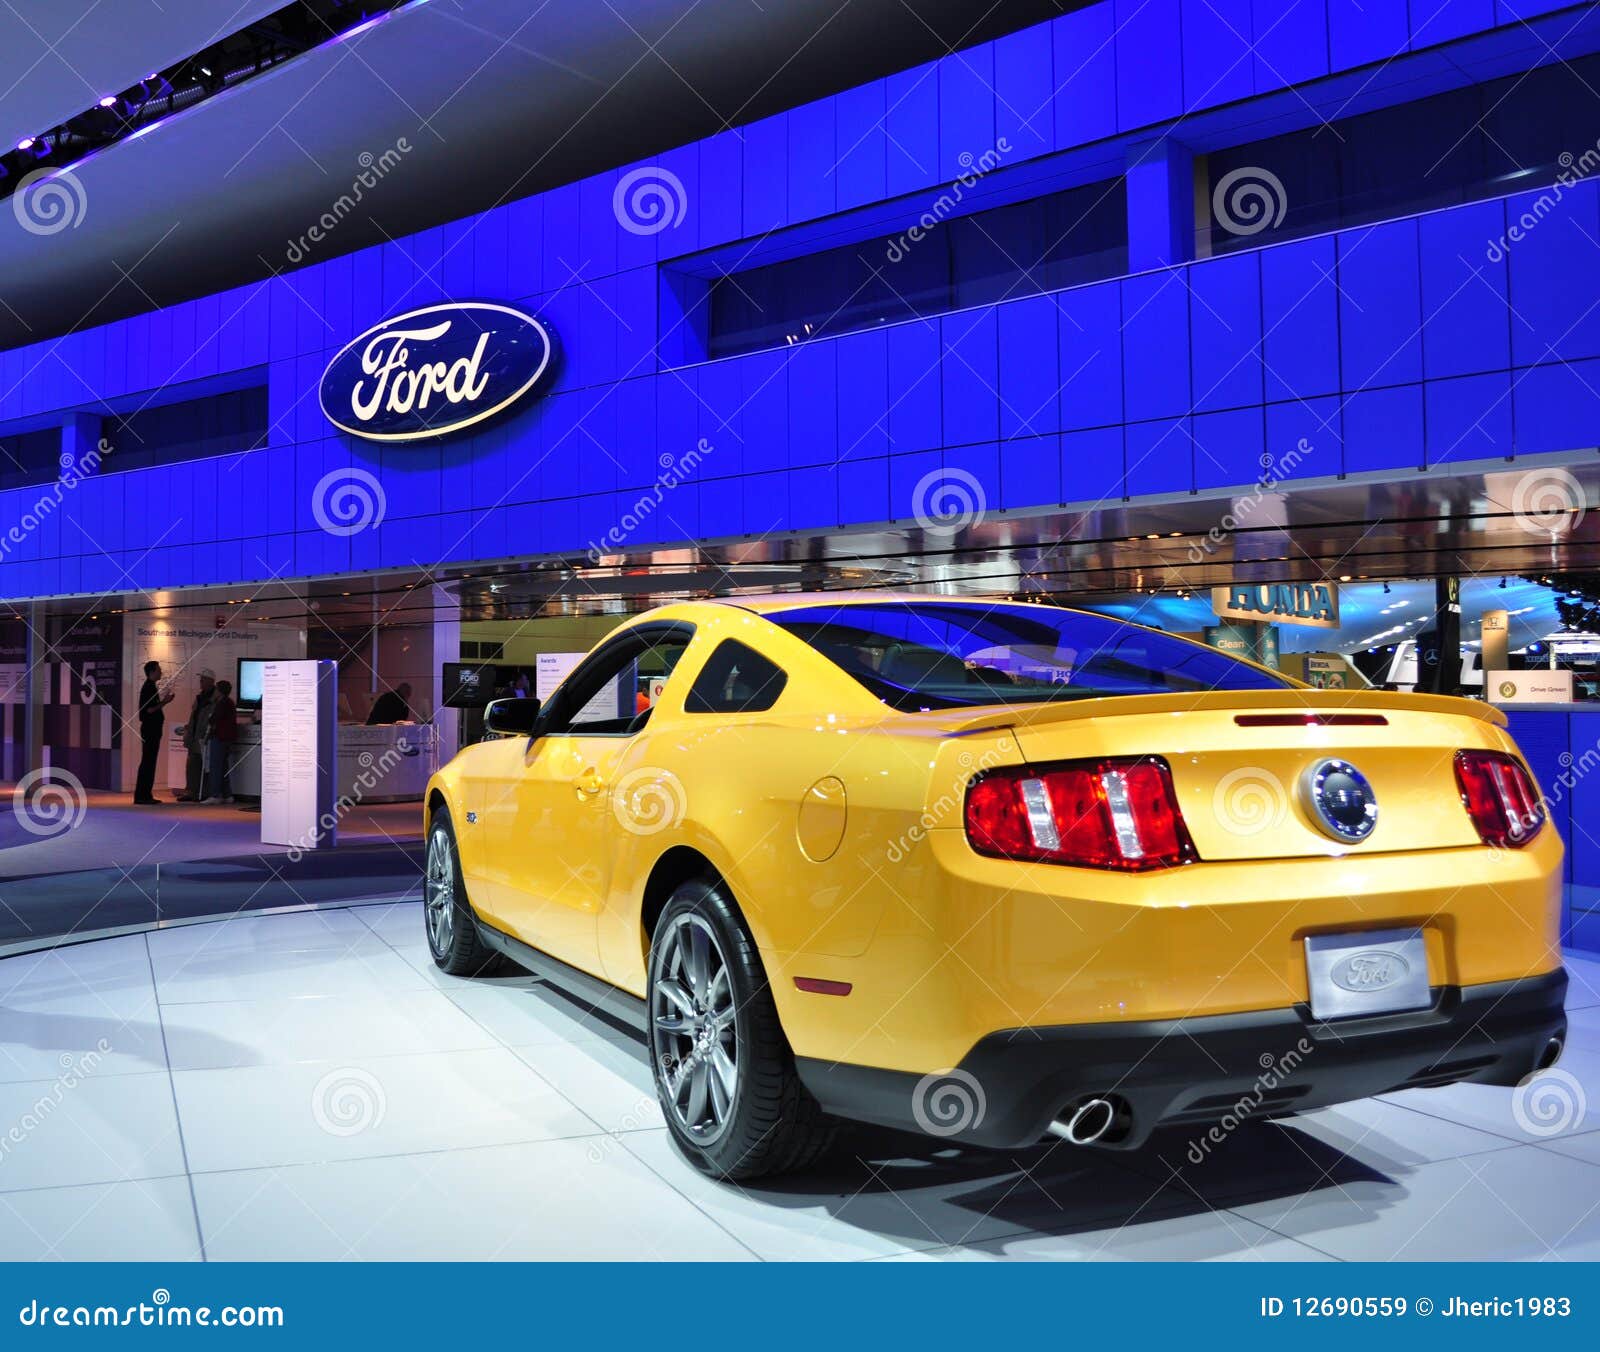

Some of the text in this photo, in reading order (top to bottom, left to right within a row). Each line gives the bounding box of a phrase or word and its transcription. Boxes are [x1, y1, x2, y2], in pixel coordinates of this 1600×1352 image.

[351, 320, 490, 421] Ford
[1227, 583, 1336, 621] HONDA
[138, 627, 176, 637] Southeast
[178, 629, 212, 640] Michigan
[1217, 639, 1245, 649] Clean
[460, 674, 479, 682] FORD
[1346, 958, 1391, 986] Ford
